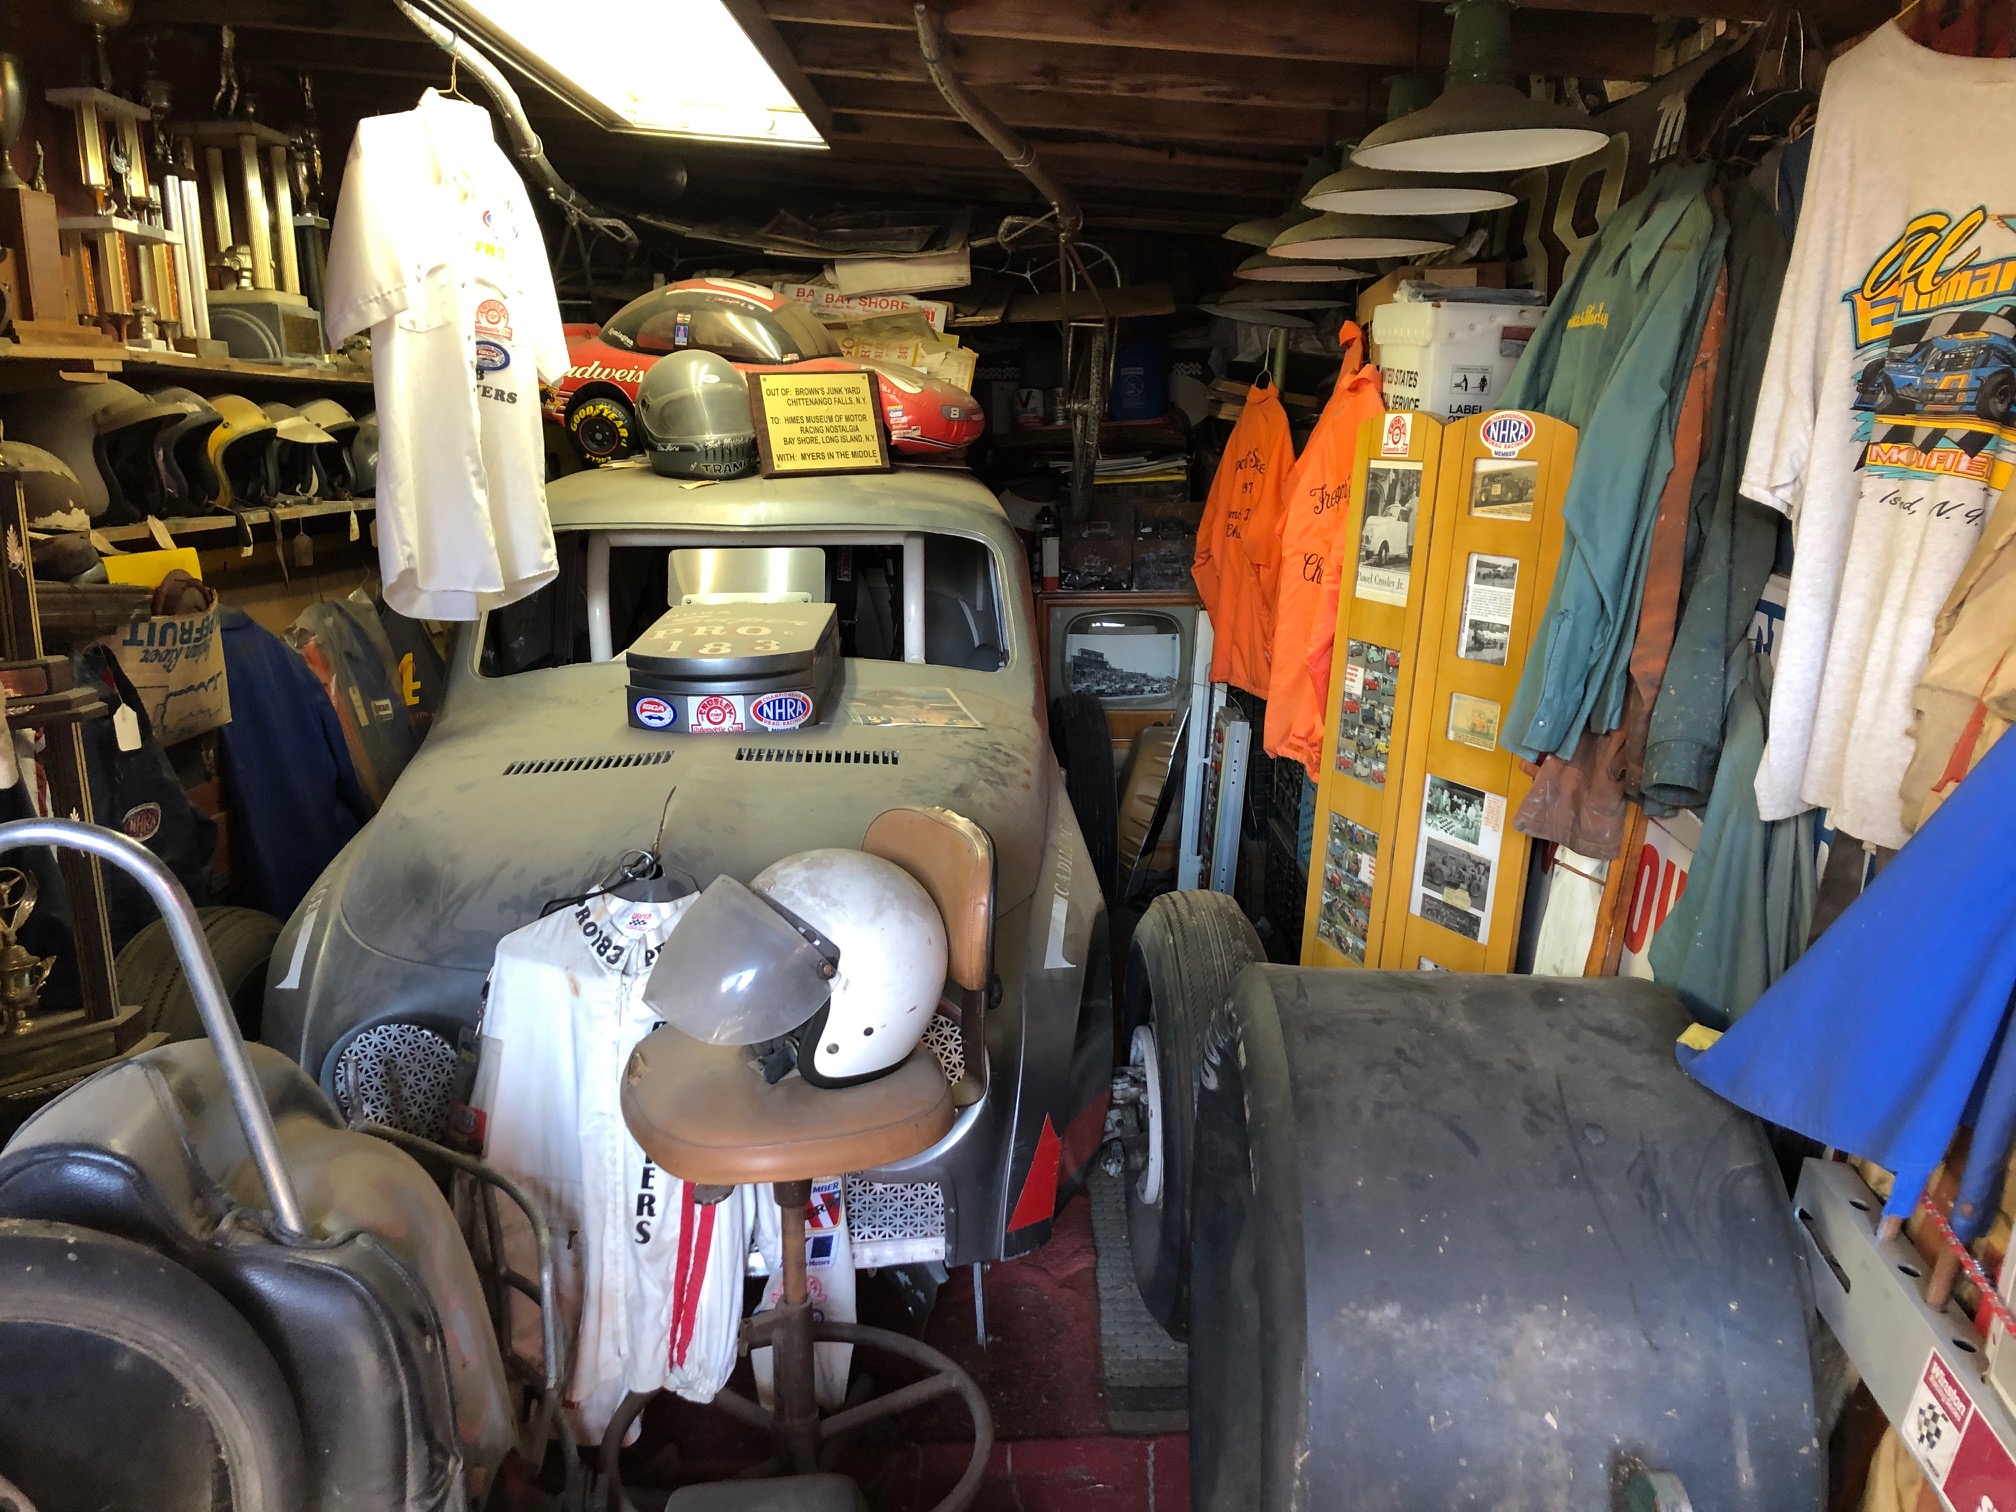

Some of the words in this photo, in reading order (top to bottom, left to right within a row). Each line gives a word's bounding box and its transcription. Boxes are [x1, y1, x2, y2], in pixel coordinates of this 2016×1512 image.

[796, 288, 815, 298] BA
[858, 296, 910, 311] SHORE
[1394, 368, 1418, 388] STATES
[766, 388, 780, 396] OUT
[781, 388, 792, 396] OF:
[795, 387, 825, 396] BROWN'S
[826, 387, 843, 395] JUNK
[844, 386, 861, 395] YARD
[786, 397, 833, 407] CHITTENANGO
[784, 416, 804, 424] HIMES
[806, 415, 833, 423] MUSEUM
[844, 414, 867, 422] MOTOR
[950, 407, 960, 419] 8
[800, 426, 824, 434] RACING
[825, 425, 860, 433] NOSTALGIA
[1489, 420, 1526, 443] NHRA
[783, 437, 796, 445] BAY
[821, 435, 839, 444] LONG
[776, 454, 797, 462] WITH:
[800, 452, 826, 461] MYERS
[835, 451, 849, 459] THE
[851, 450, 877, 459] MIDDLE
[1374, 574, 1396, 592] Crosley
[1396, 579, 1405, 590] Jr.
[648, 625, 772, 640] PRO
[663, 640, 781, 655] 183
[762, 692, 802, 702] CHAMPIONSHIP
[699, 698, 734, 716] CROSLEY
[763, 699, 803, 720] NHRA
[783, 715, 805, 726] RACING
[812, 1182, 839, 1193] MBER
[634, 1160, 657, 1245] ERS
